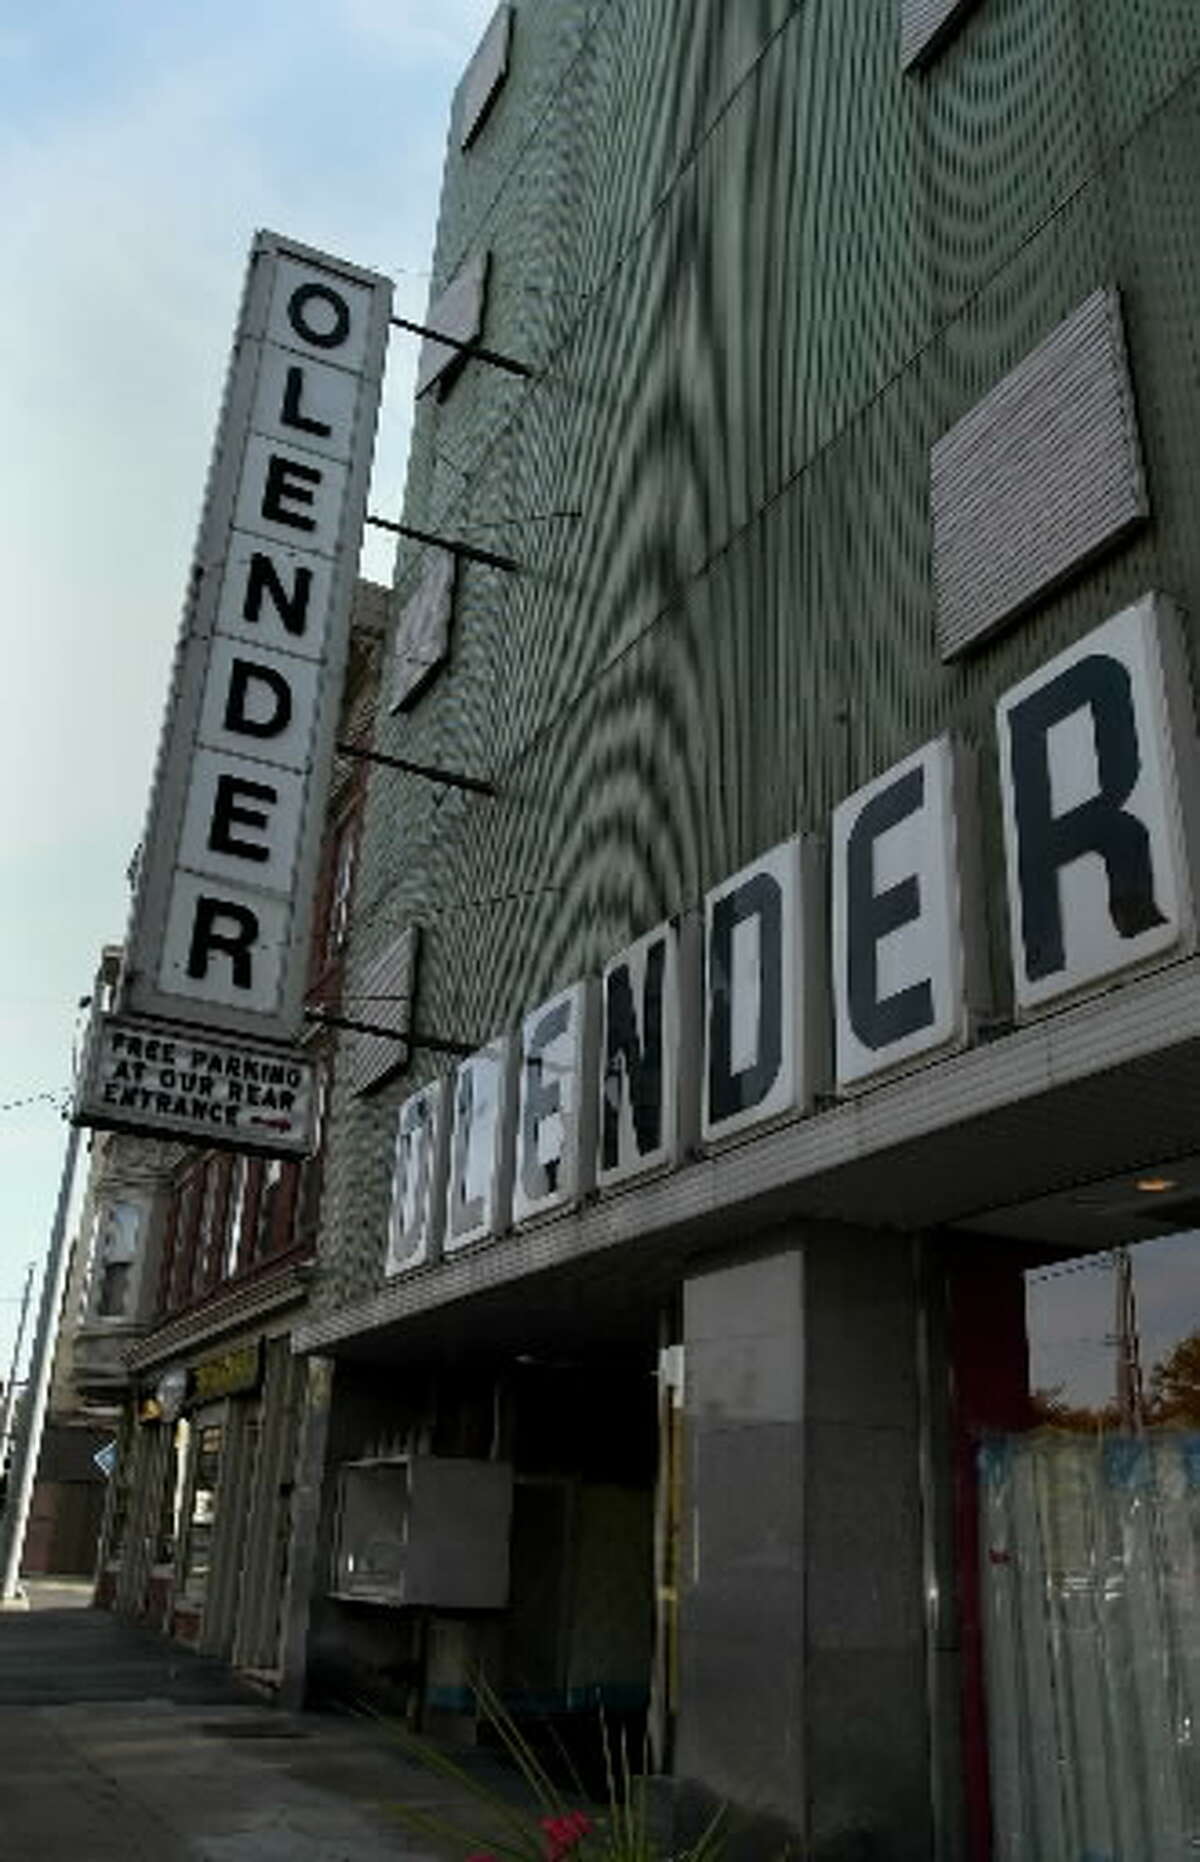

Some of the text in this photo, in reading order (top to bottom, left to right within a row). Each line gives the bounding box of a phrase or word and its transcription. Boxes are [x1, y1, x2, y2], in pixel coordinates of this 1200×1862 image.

[186, 282, 351, 990] OLENDER
[391, 653, 1169, 1261] OLENDER
[112, 1032, 301, 1089] FREE PARKING
[113, 1060, 297, 1112] AT OUR REAR
[104, 1083, 241, 1127] ENTRANCE
